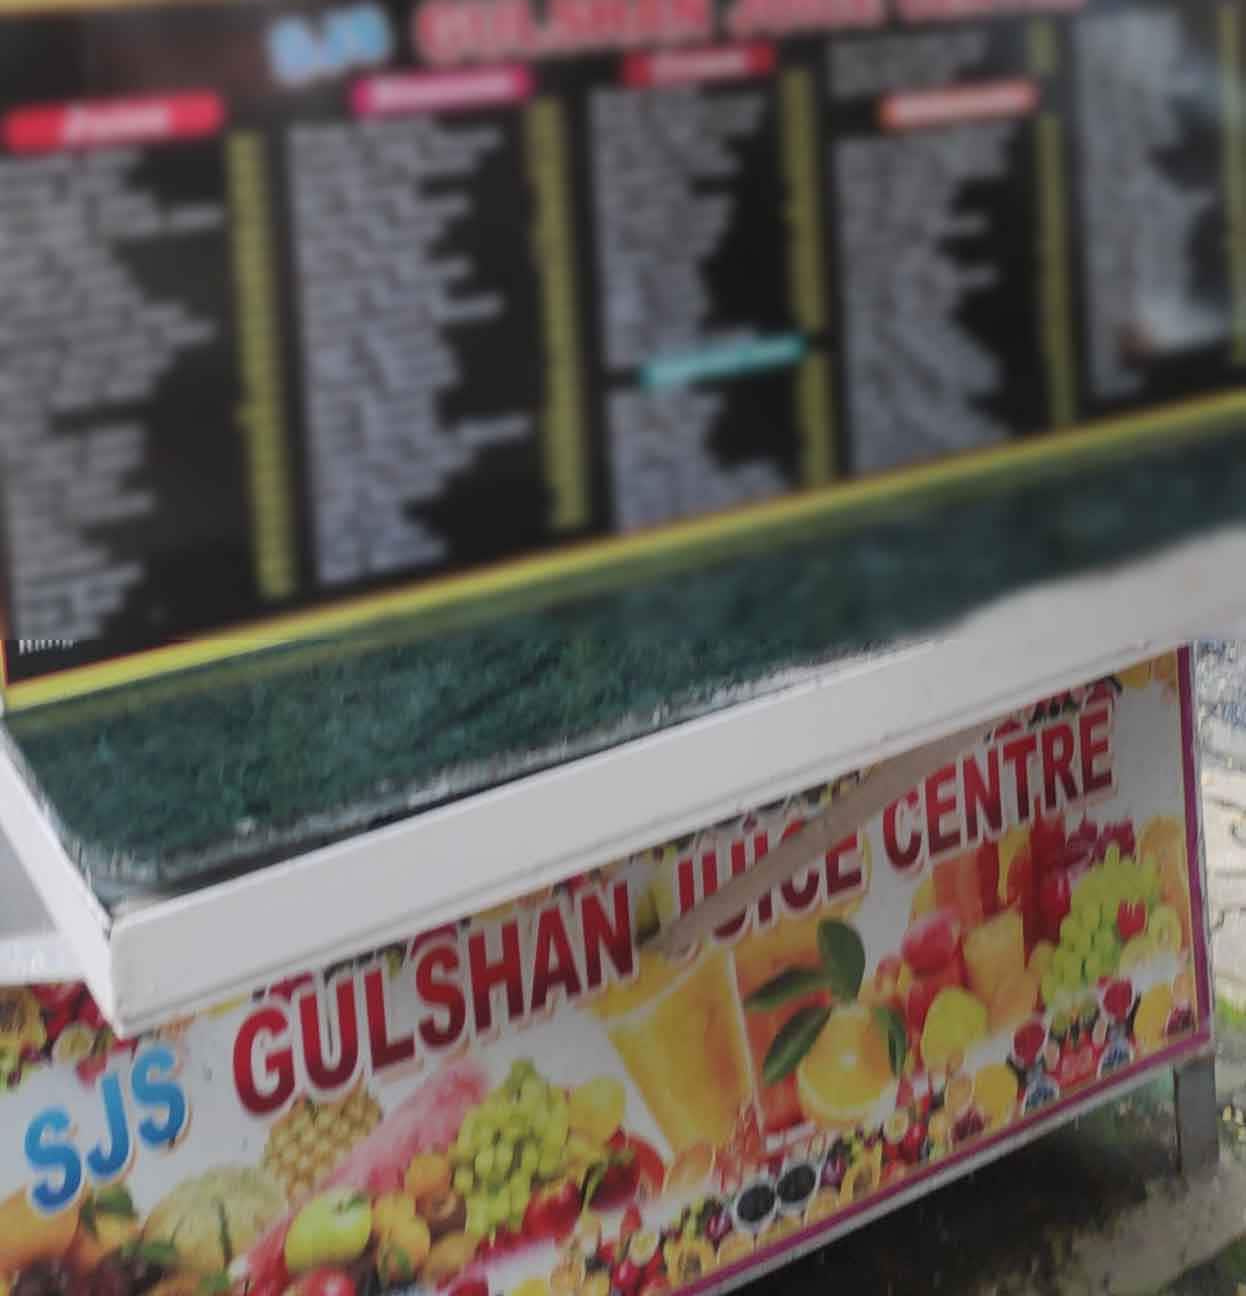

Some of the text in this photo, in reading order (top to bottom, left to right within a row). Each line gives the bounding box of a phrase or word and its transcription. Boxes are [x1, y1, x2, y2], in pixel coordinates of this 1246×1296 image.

[24, 1046, 186, 1211] SJS
[233, 880, 634, 1116] GULSHAN
[881, 700, 1114, 872] CENTRE
